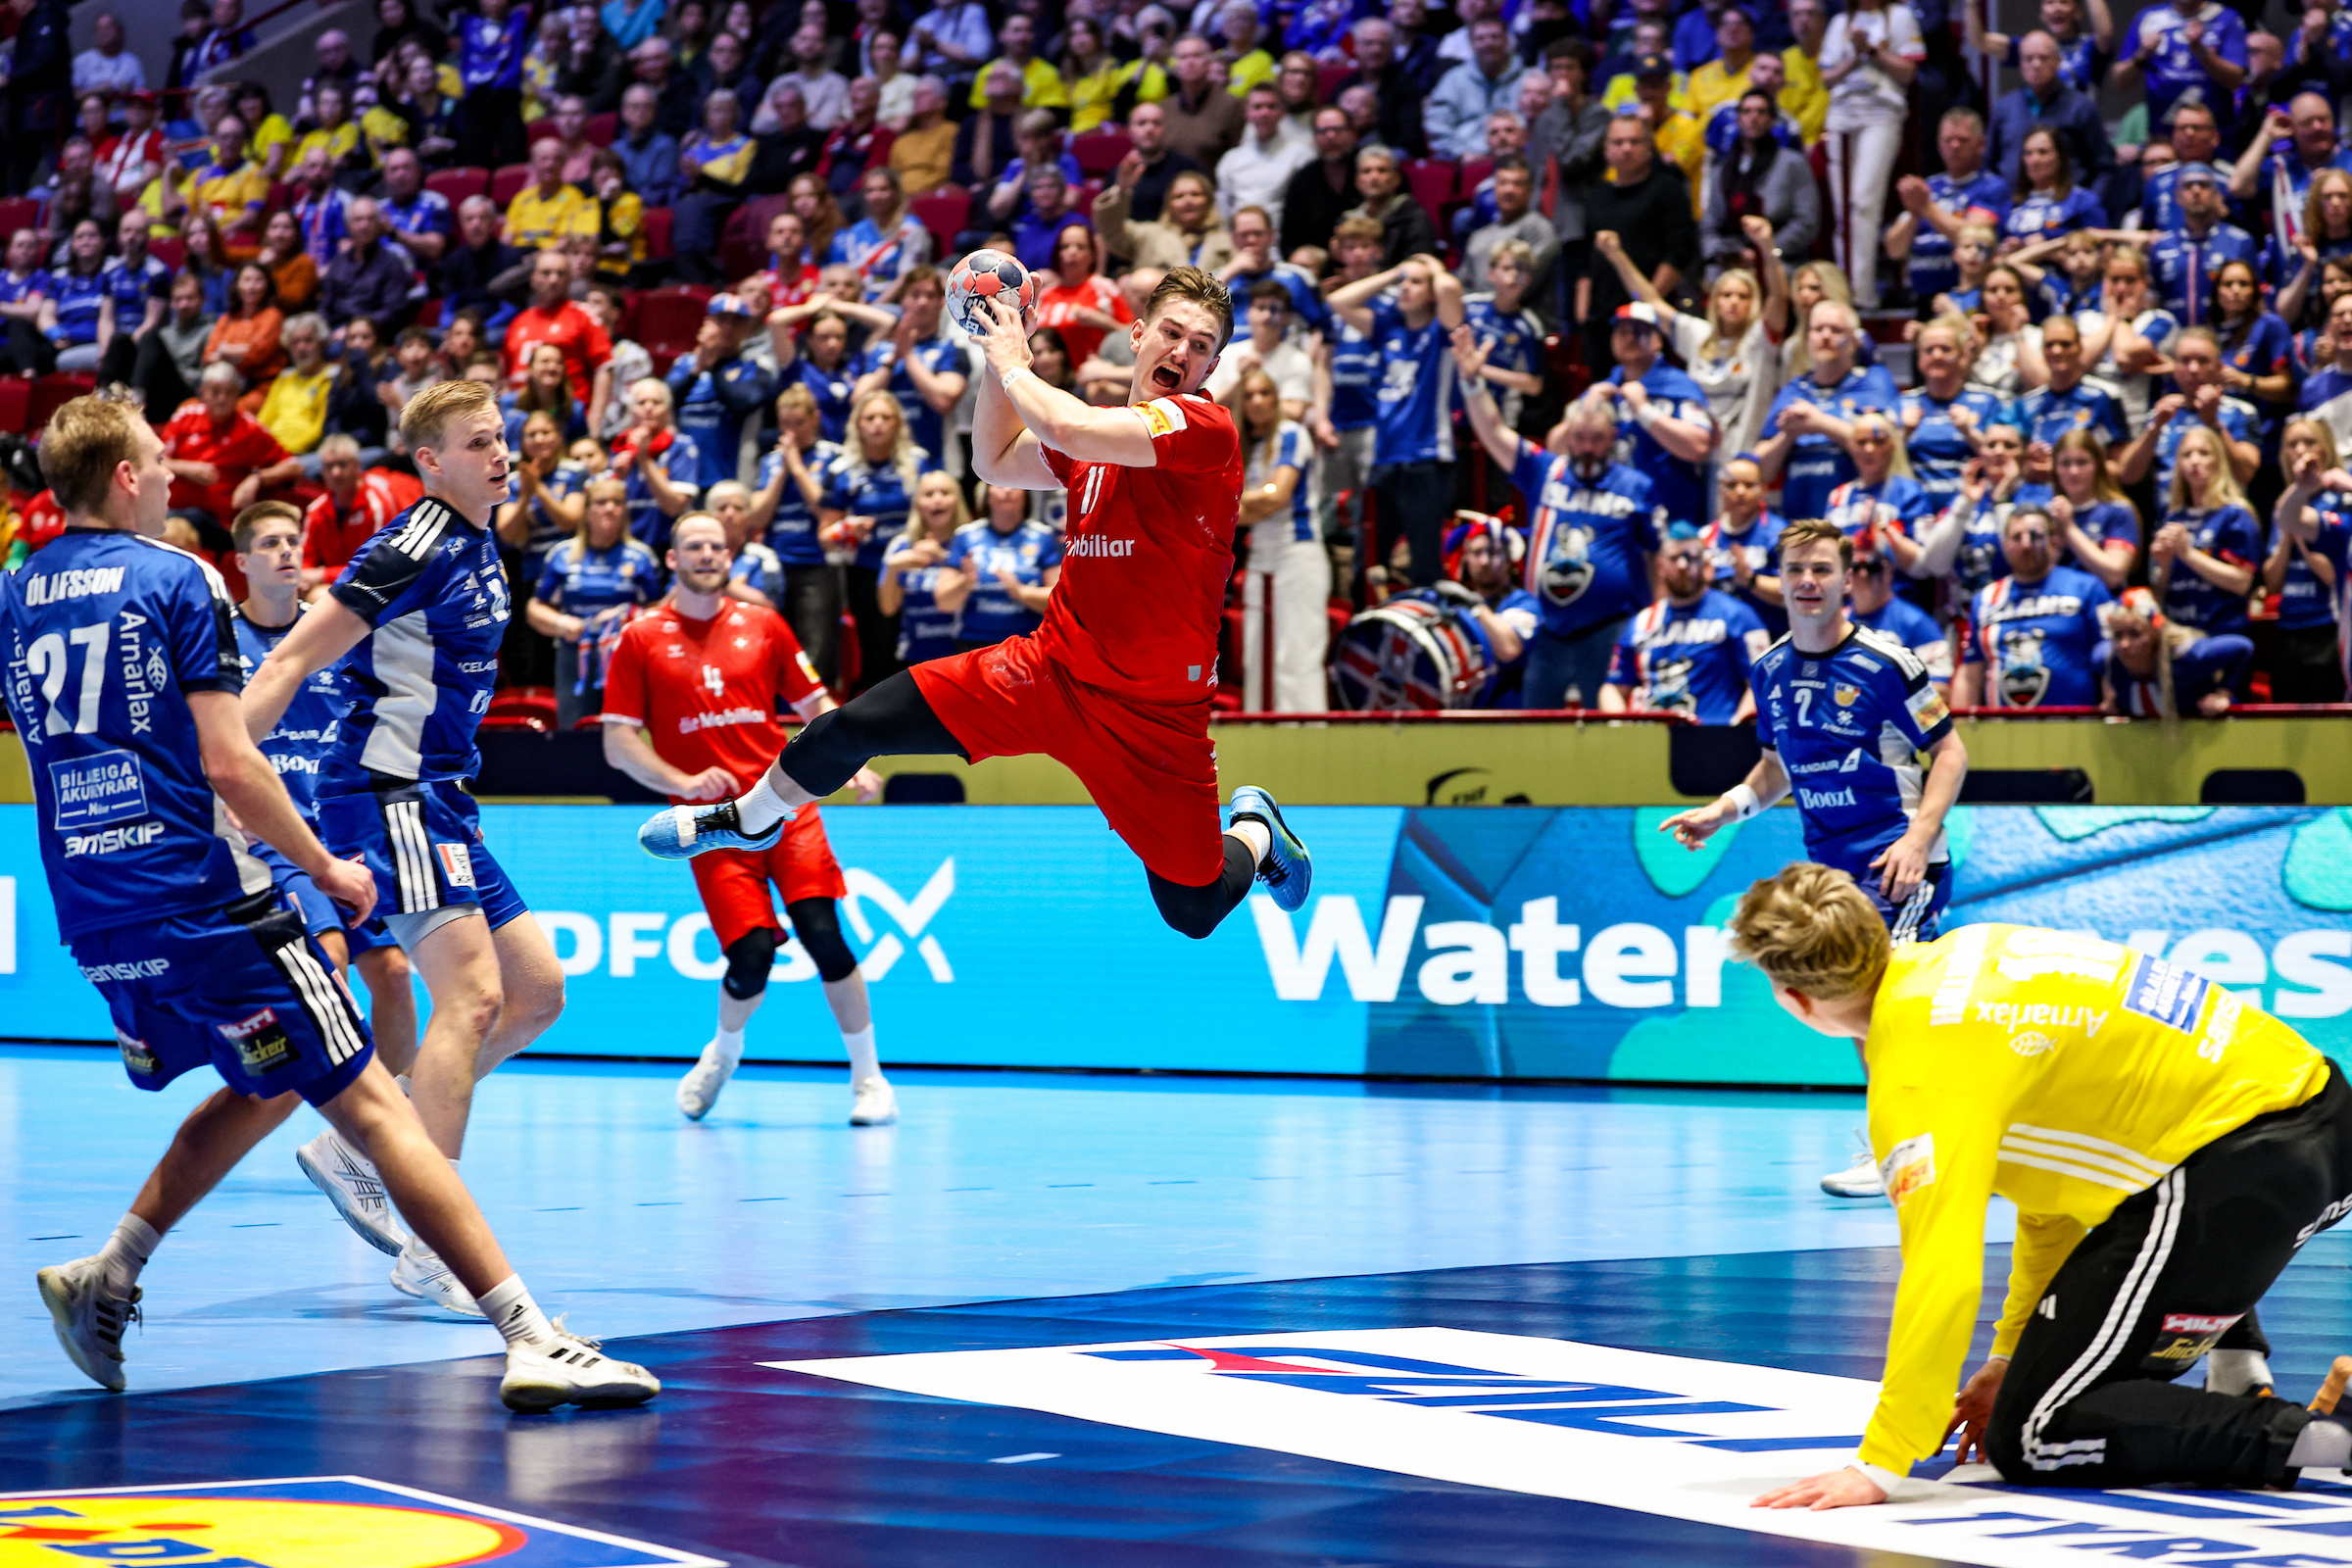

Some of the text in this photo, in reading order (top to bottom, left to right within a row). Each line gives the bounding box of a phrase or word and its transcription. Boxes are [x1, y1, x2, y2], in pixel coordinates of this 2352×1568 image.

[1080, 466, 1105, 514] 11
[25, 566, 125, 607] ÓLAFSSON
[26, 621, 110, 736] 27
[120, 611, 155, 735] Arnarlax
[703, 664, 724, 697] 4
[1793, 688, 1814, 727] 2
[1250, 894, 1733, 1008] Water
[1975, 1001, 2110, 1039] Arnarlax
[2165, 1314, 2241, 1331] HILT
